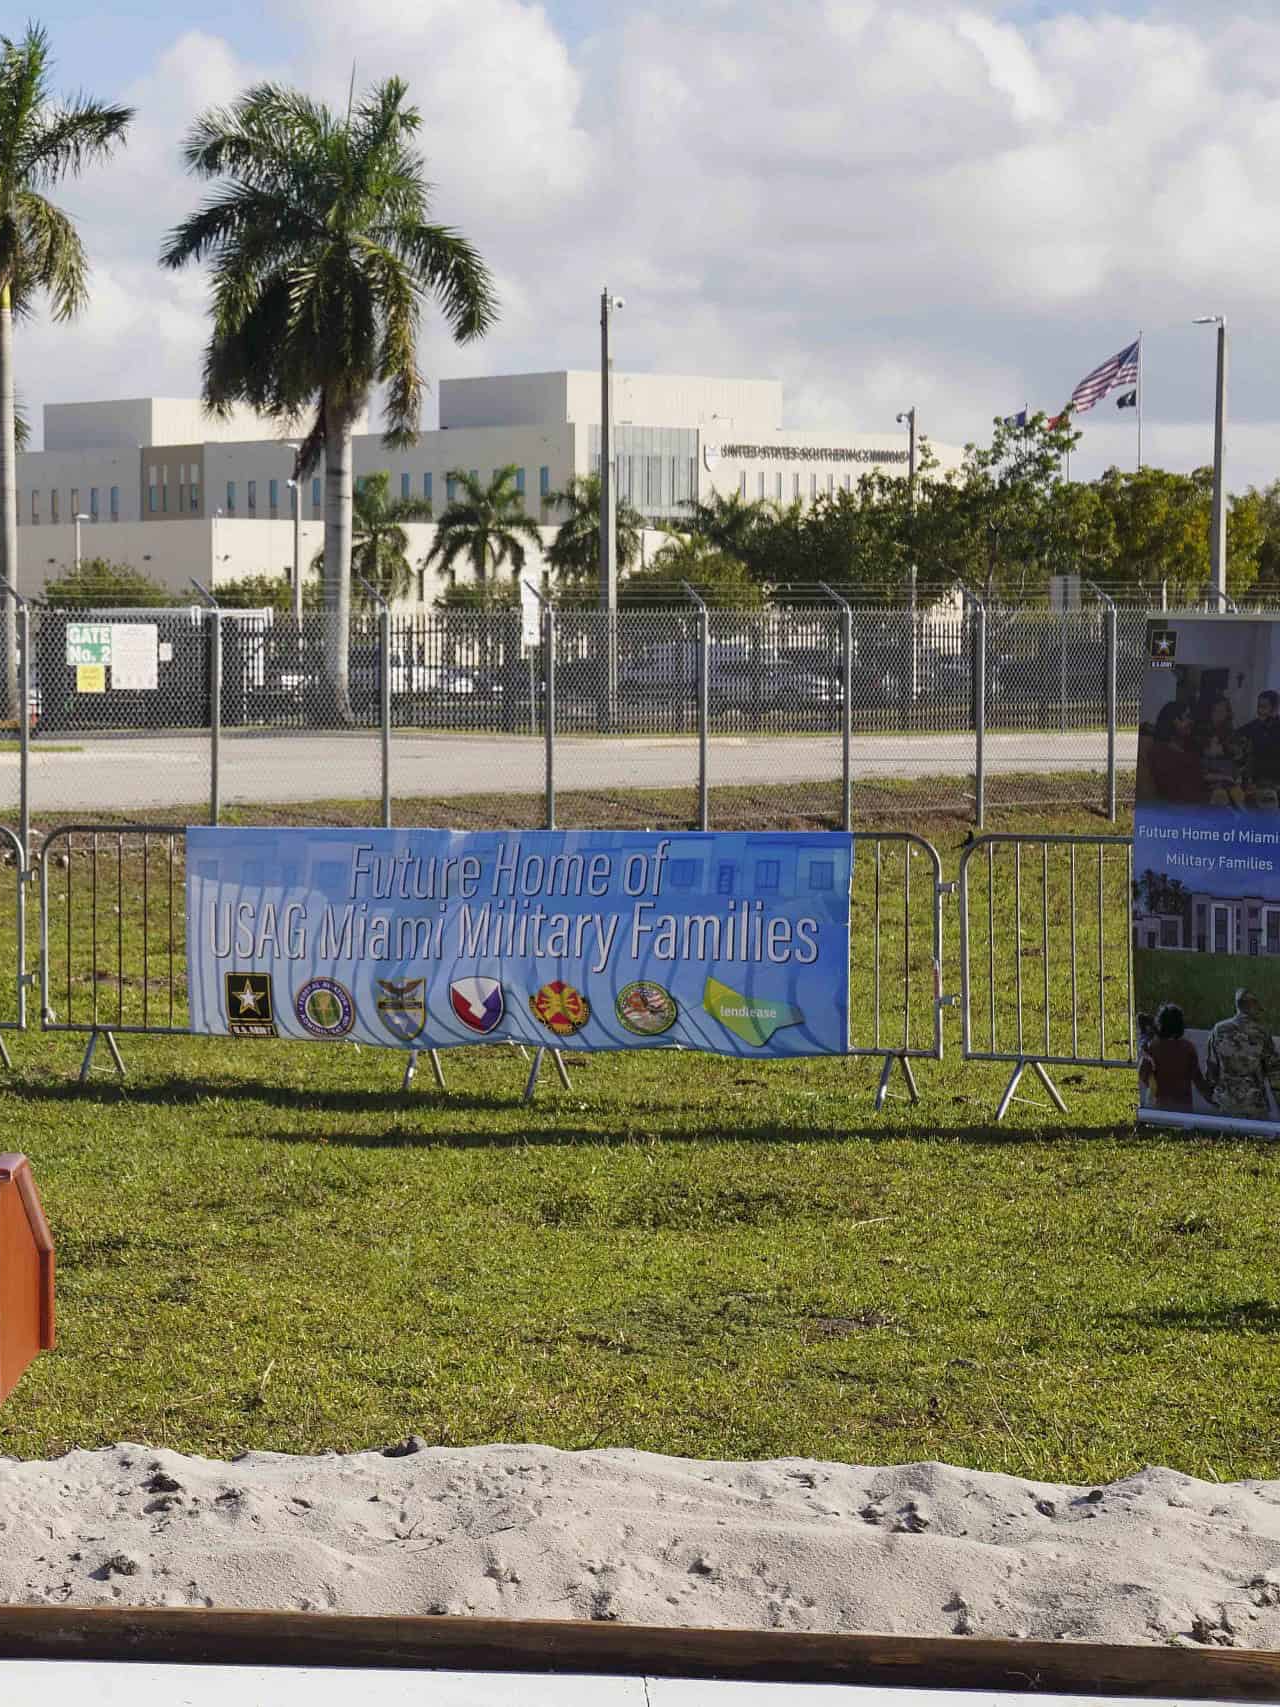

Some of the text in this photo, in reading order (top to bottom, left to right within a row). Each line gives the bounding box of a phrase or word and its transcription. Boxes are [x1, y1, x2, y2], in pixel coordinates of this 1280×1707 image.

[720, 444, 759, 459] UNITED
[760, 446, 799, 461] STATES
[800, 447, 856, 463] SOUTHERN
[69, 626, 110, 643] GATE
[101, 645, 111, 664] 2
[1139, 825, 1279, 844] Future Home of Miami
[349, 839, 671, 900] Future Home of
[1166, 853, 1273, 871] Military Families
[209, 898, 819, 974] USAG Miami Military Families
[720, 1003, 777, 1018] lendlease
